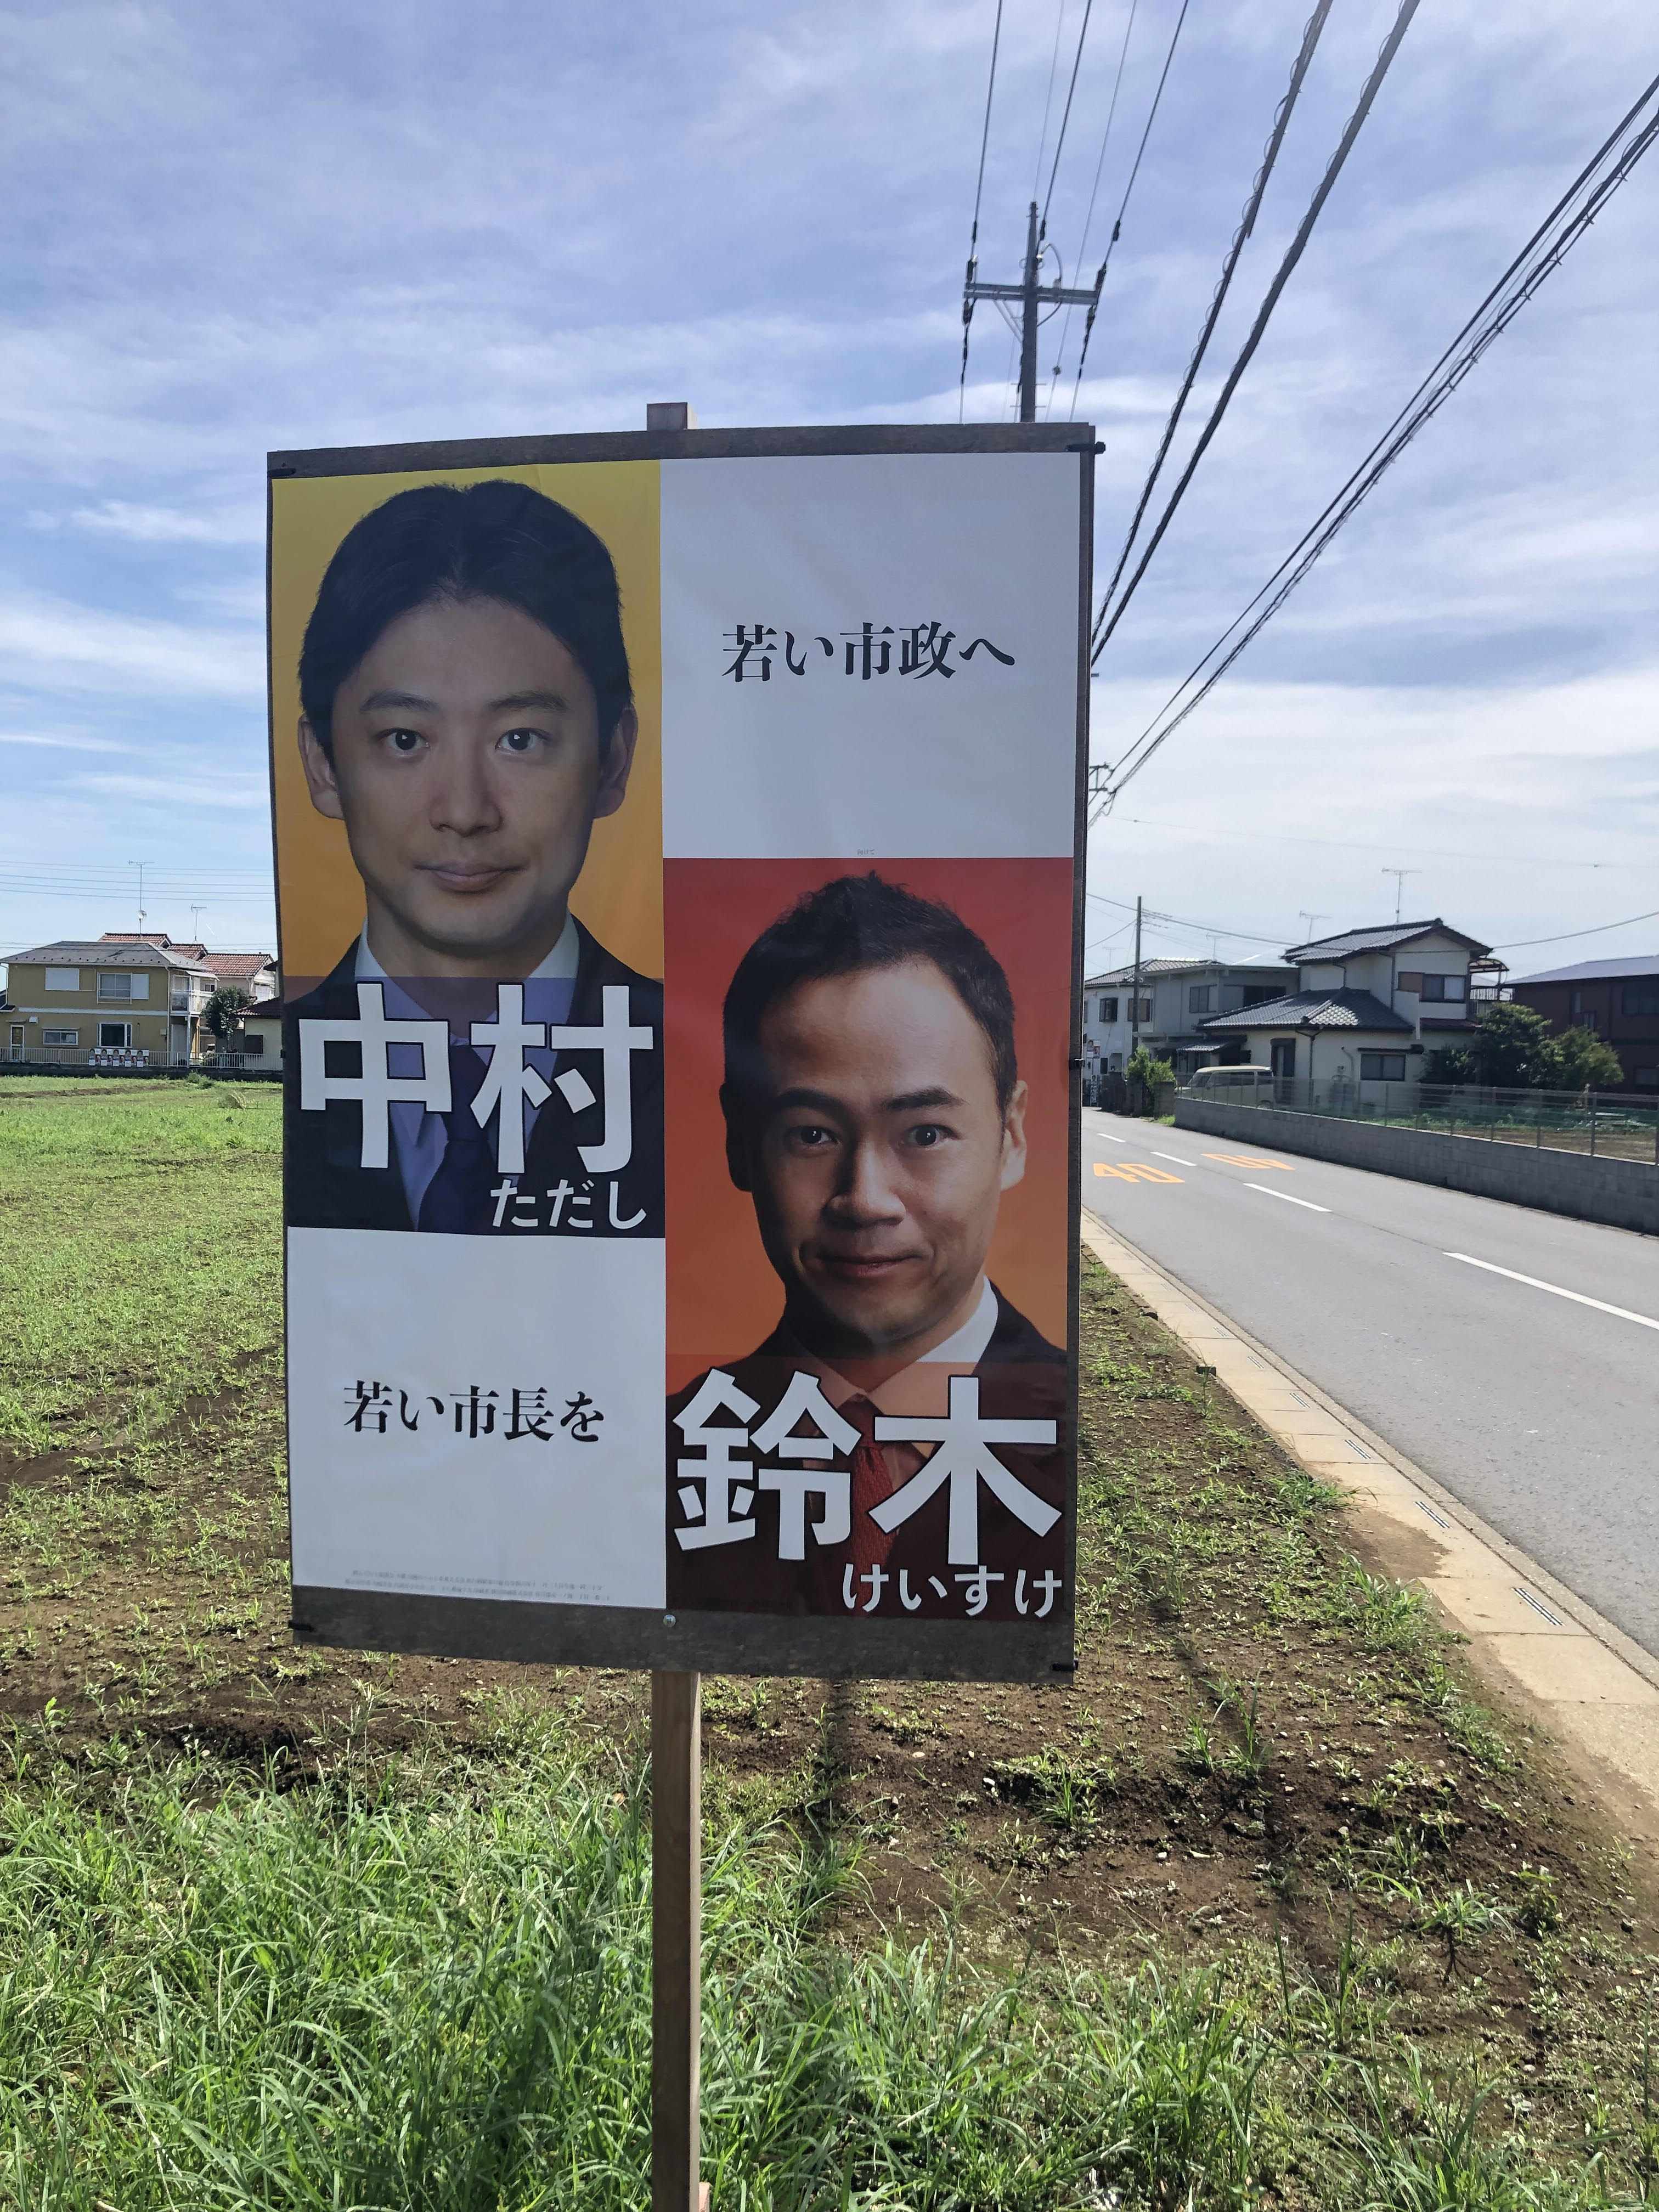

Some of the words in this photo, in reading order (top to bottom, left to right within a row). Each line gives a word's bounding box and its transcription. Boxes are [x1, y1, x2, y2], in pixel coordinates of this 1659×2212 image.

[721, 621, 1015, 681] 若い市政へ
[298, 983, 653, 1173] 中村
[1093, 1163, 1185, 1183] 40
[490, 1179, 647, 1229] ただし
[343, 1380, 604, 1442] 若い市長を
[673, 1368, 1062, 1565] 鈴木
[843, 1563, 1062, 1618] けいすけ
